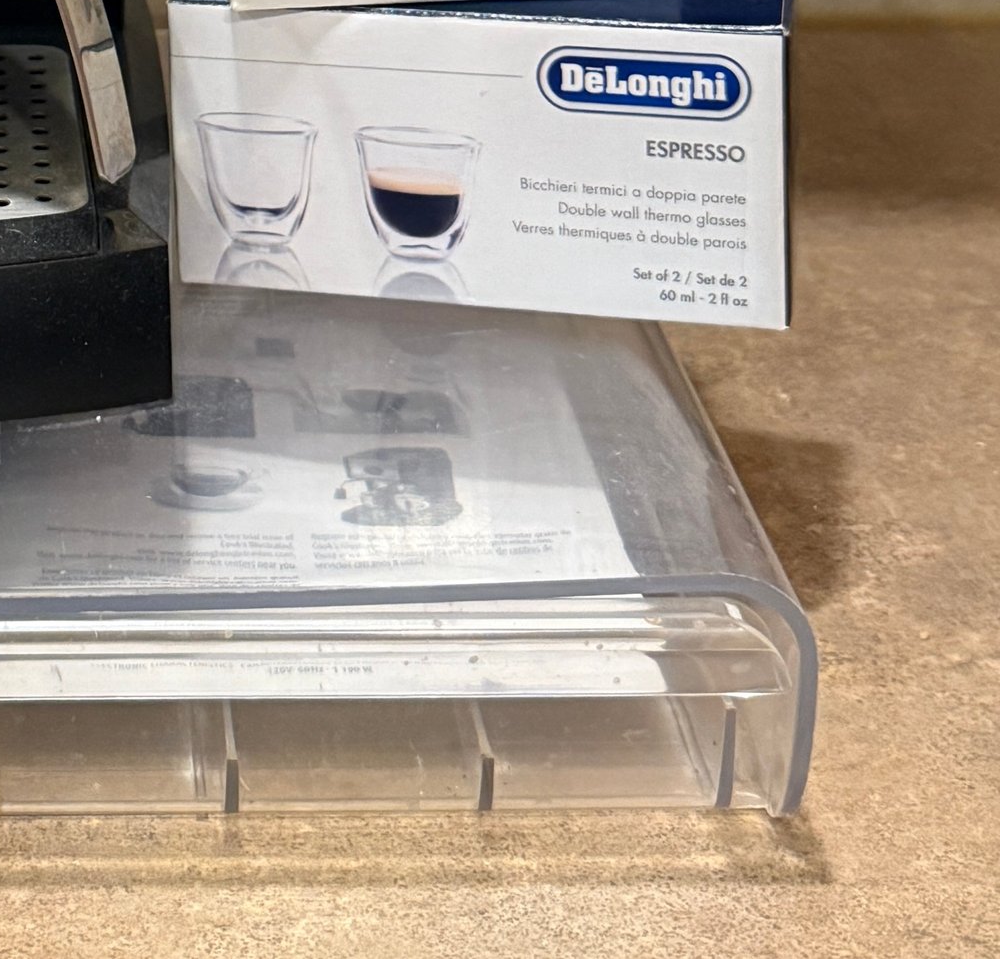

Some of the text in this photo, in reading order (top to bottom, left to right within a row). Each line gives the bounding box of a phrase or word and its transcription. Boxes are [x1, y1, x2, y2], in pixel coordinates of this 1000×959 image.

[645, 139, 746, 163] ESPRESSO
[519, 177, 748, 206] Bicchieri termici a doppia parete
[558, 201, 748, 229] Double wall thermo glasses
[512, 220, 748, 251] Verres thermiques à double parois
[633, 267, 748, 288] Set of 2 / Set de 2
[659, 289, 677, 301] 60
[680, 290, 696, 303] ml
[708, 293, 717, 304] 2
[720, 293, 730, 306] fl
[732, 297, 748, 307] oz
